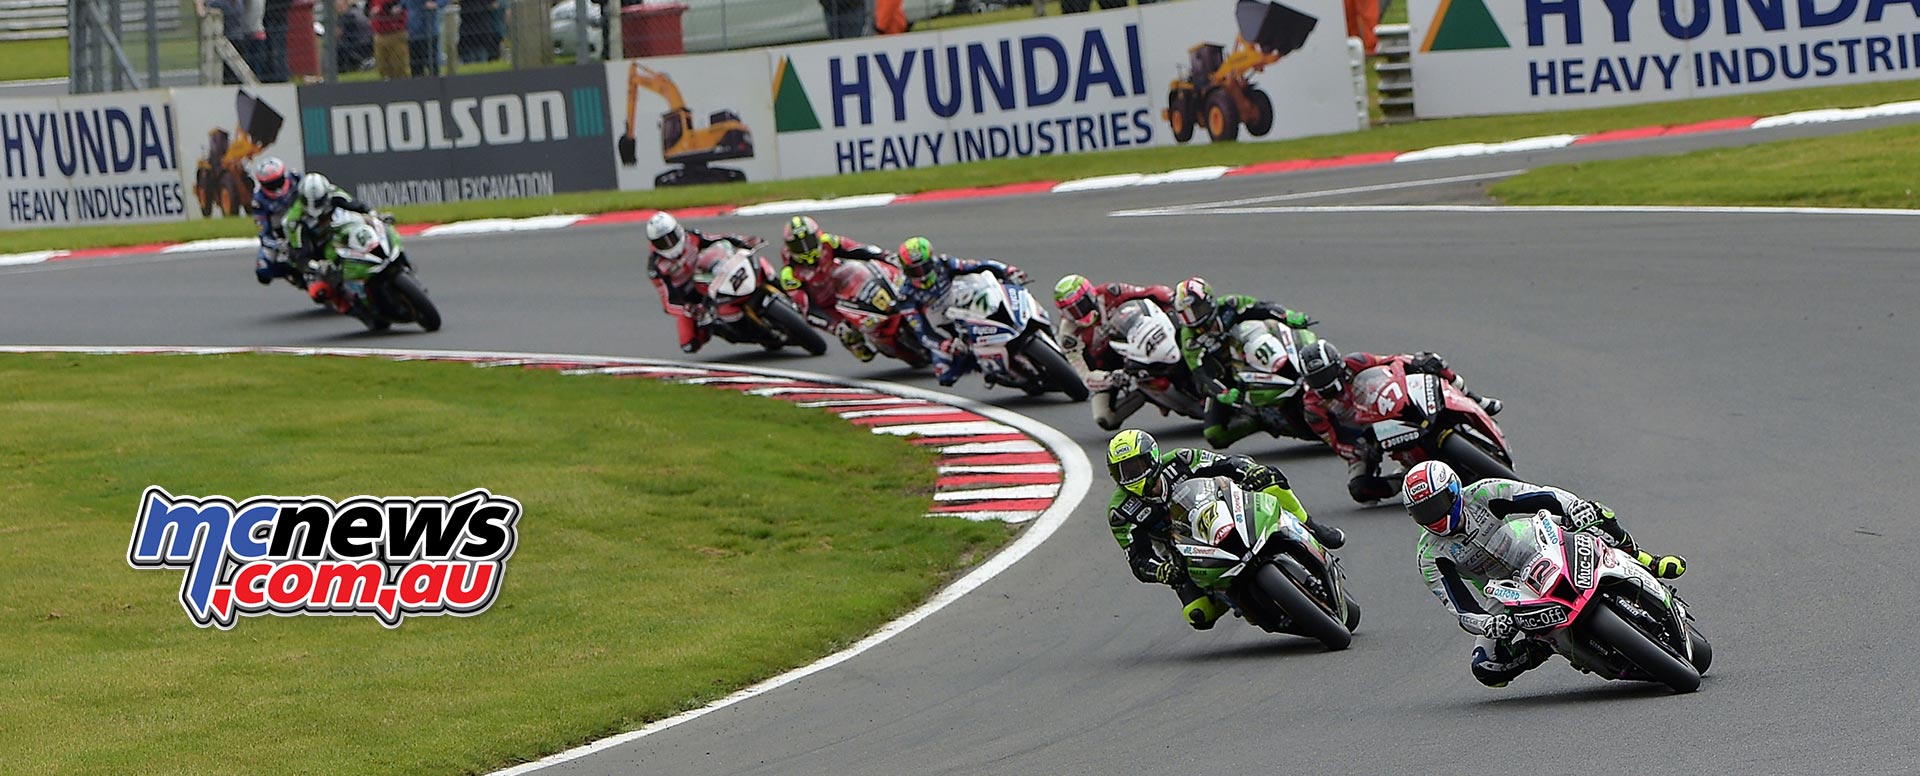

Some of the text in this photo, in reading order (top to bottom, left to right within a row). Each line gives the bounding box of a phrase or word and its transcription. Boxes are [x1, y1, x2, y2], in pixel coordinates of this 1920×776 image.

[829, 24, 1146, 127] HYUNDAI
[1529, 54, 1681, 96] HEAVY
[1, 104, 178, 177] HYUNDAI
[836, 108, 1153, 174] HEAVY INDUSTRIES
[9, 182, 185, 222] HEAVY INDUSTRIES
[459, 171, 554, 200] EXCAVATION
[1254, 341, 1278, 366] 91
[1377, 381, 1404, 416] 47
[1525, 558, 1561, 597] 12
[1576, 535, 1592, 587] Muc-Off
[1494, 588, 1521, 600] OXFORD
